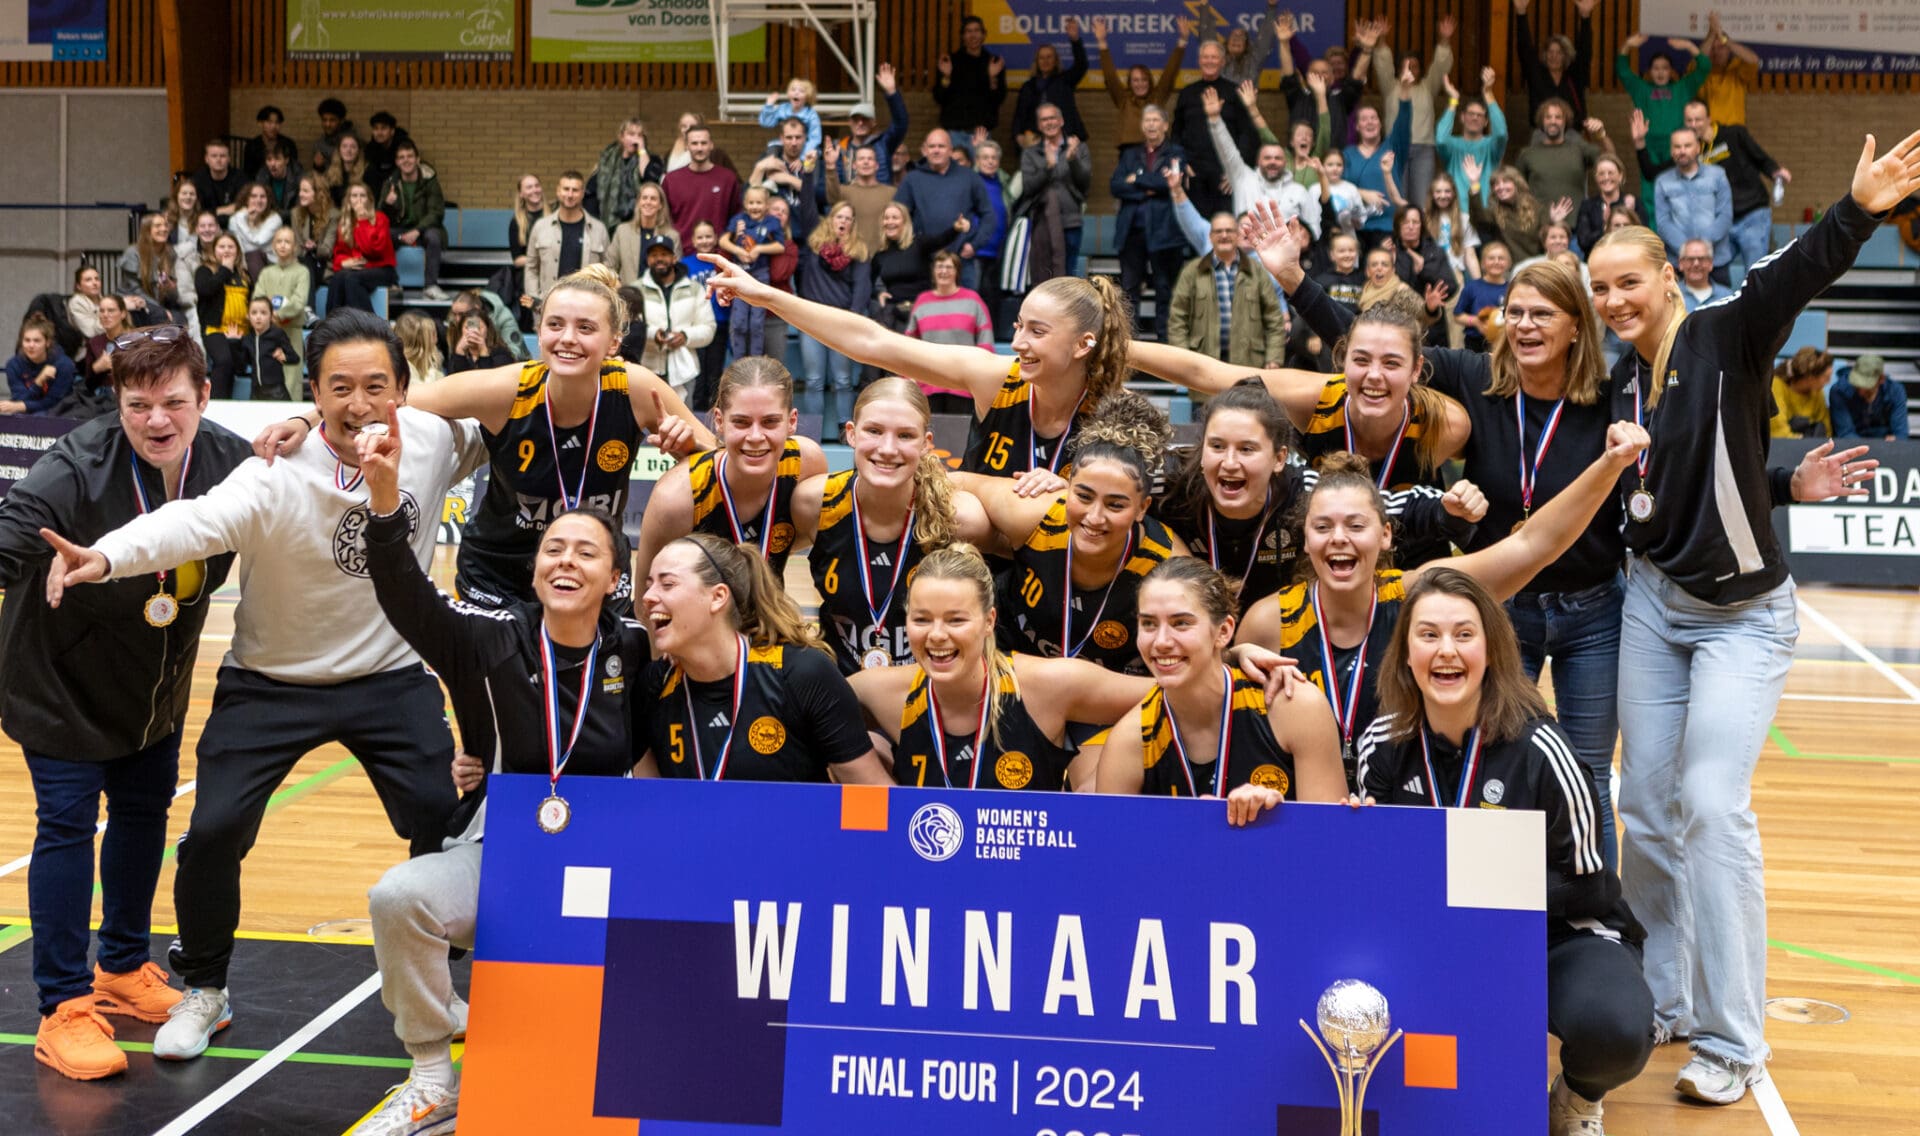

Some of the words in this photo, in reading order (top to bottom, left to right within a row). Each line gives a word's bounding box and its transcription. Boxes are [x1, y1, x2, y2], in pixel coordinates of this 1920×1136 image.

[476, 14, 496, 31] de
[628, 14, 656, 26] van
[661, 11, 719, 27] Doore
[460, 29, 512, 49] Coepel
[1768, 56, 1802, 71] sterk
[1805, 57, 1821, 71] in
[1825, 55, 1867, 71] Bouw
[518, 439, 536, 473] 9
[983, 431, 1014, 470] 15
[824, 557, 840, 595] 6
[1020, 567, 1044, 608] 10
[669, 723, 684, 764] 5
[911, 754, 928, 789] 7
[977, 808, 1048, 827] WOMEN'S
[976, 828, 1078, 848] BASKETBALL
[976, 846, 1021, 860] LEAGUE
[734, 899, 1258, 1026] WINNAAR
[831, 1054, 914, 1098] FINAL
[922, 1059, 997, 1103] FOUR
[1034, 1065, 1145, 1112] 2024
